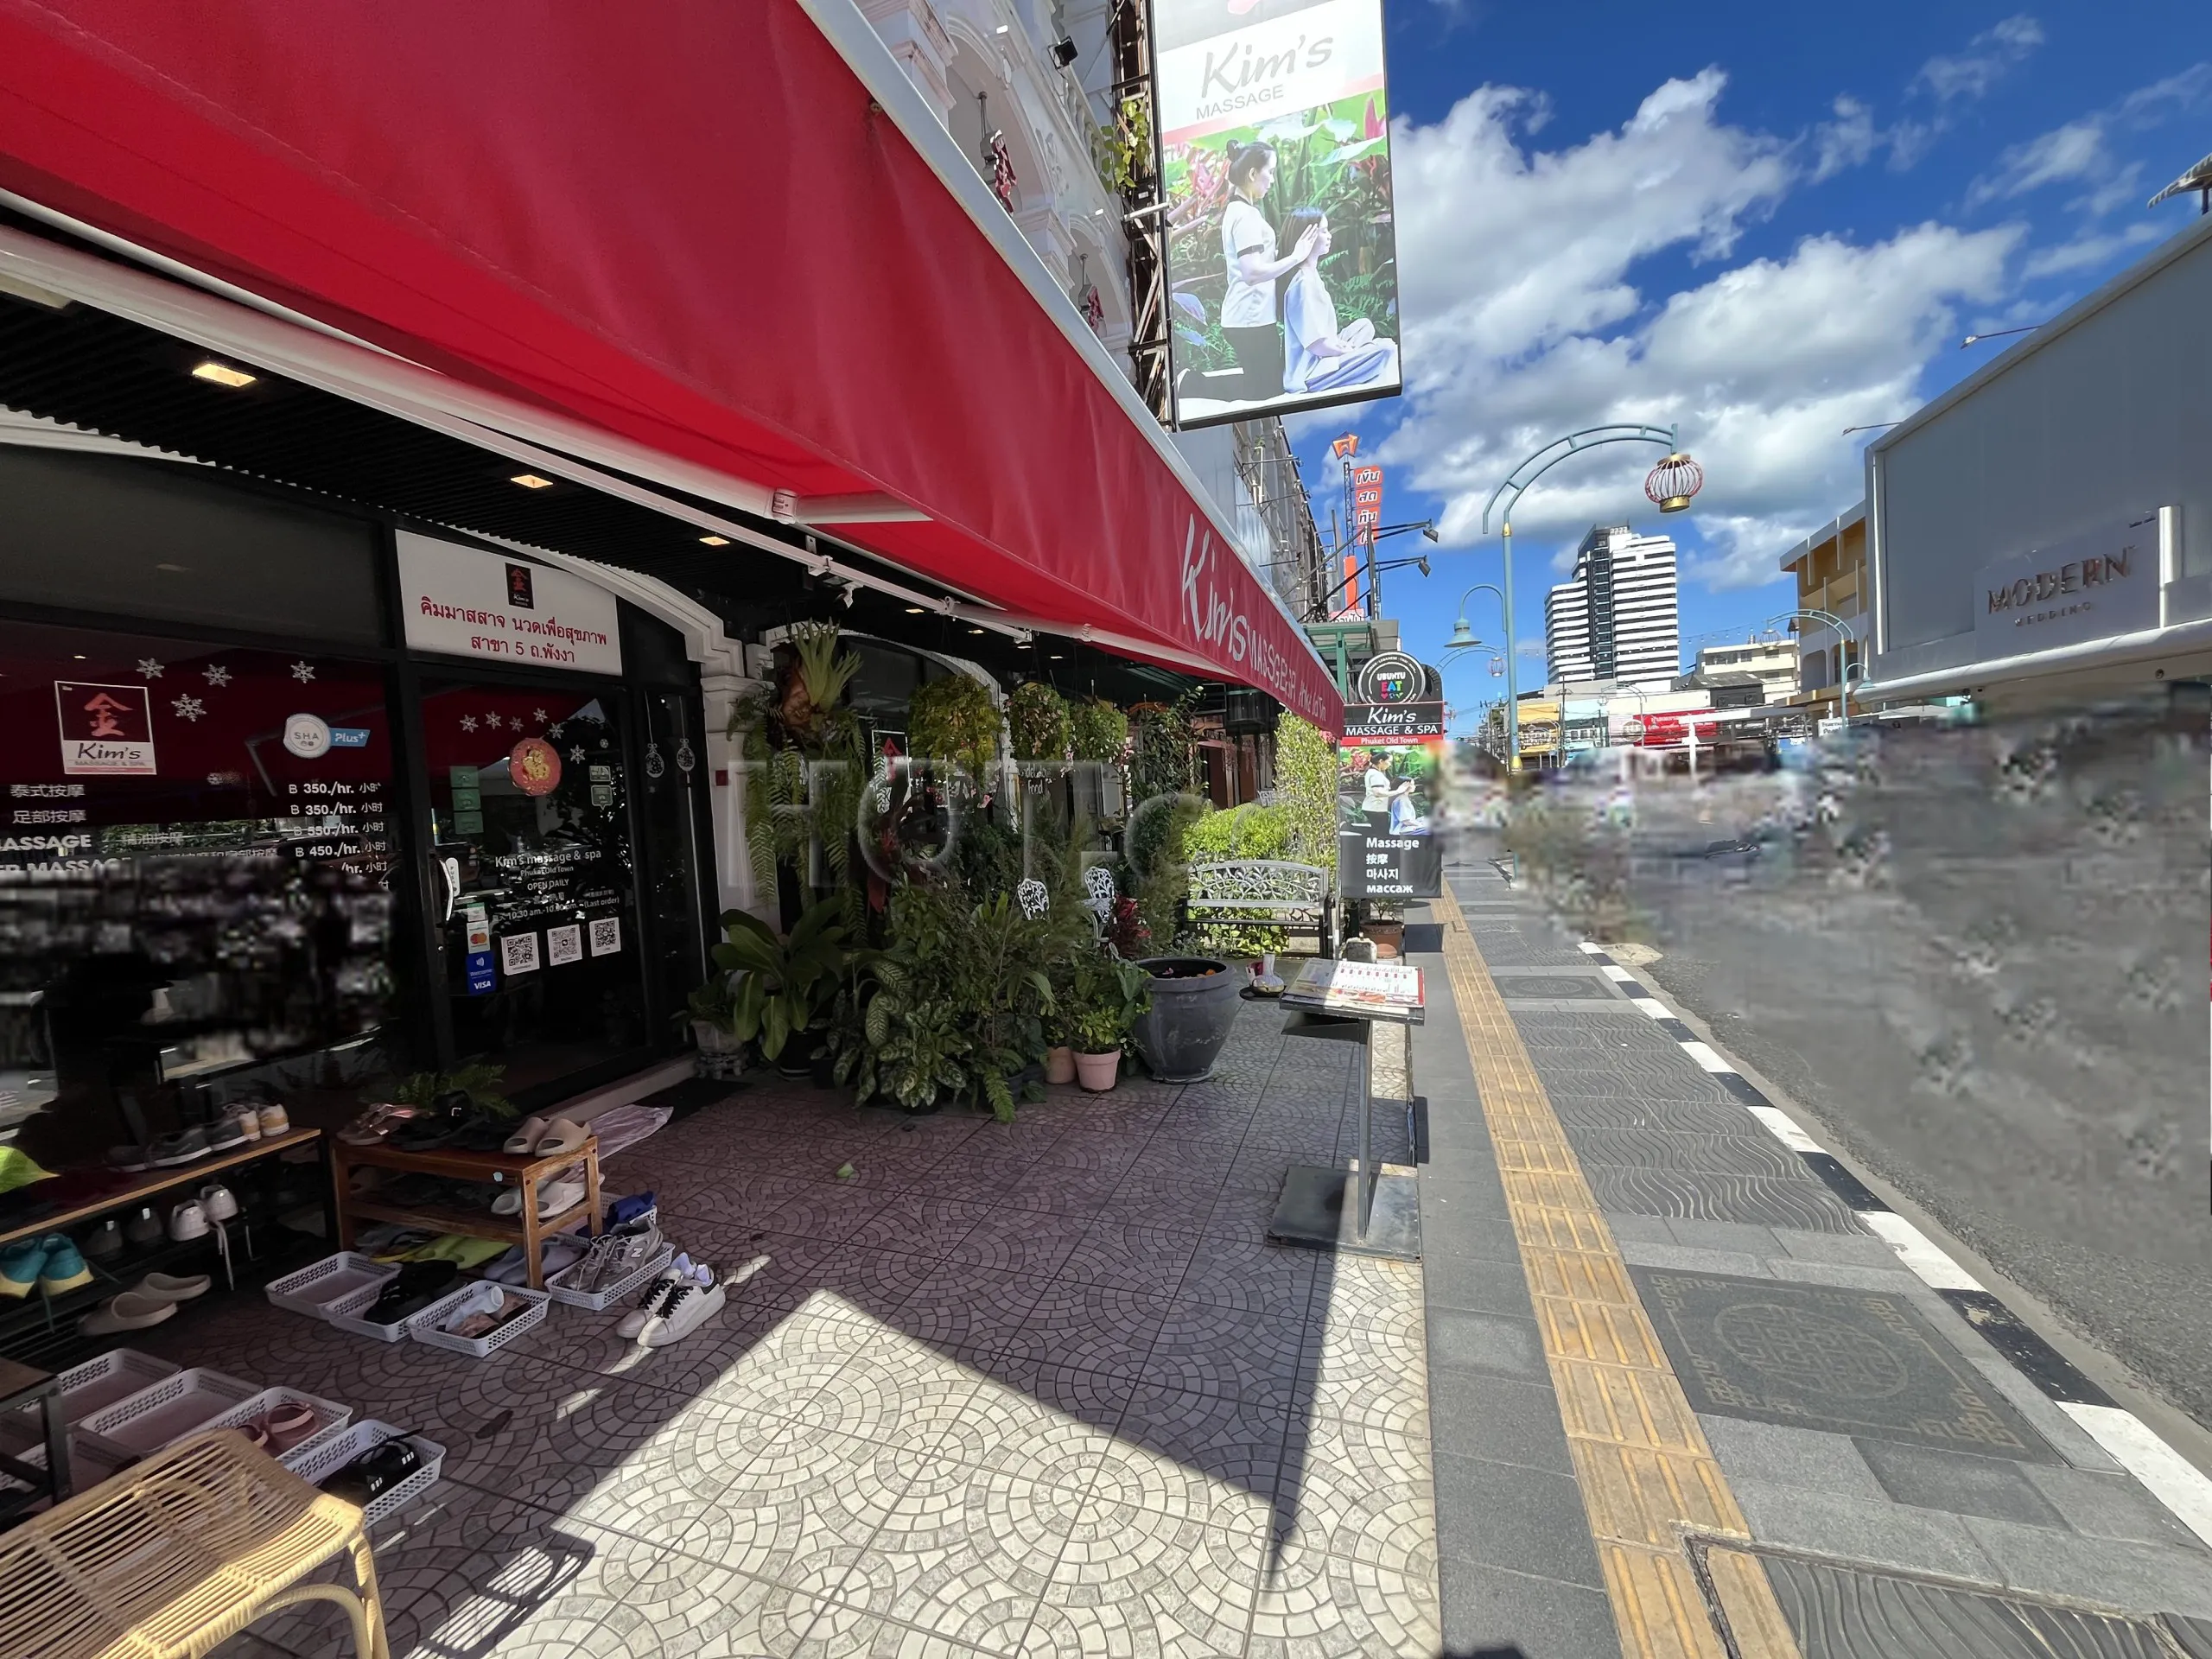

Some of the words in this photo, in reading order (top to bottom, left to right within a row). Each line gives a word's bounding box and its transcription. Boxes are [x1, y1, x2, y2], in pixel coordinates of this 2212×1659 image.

[1201, 35, 1333, 99] Kim's
[1196, 85, 1284, 120] MASSAGE
[1988, 545, 2136, 614] MODERN
[1182, 513, 1248, 661] Kim's
[421, 595, 505, 628] คิมมาสสาจ
[512, 617, 607, 645] นวดเพื่อสุขภาพ
[471, 635, 508, 653] สาขา
[515, 642, 524, 655] 5
[531, 642, 575, 663] ถ.พังงา
[1376, 672, 1406, 681] UBUNTU
[1381, 680, 1402, 692] EAT
[1367, 706, 1417, 724] Kim's
[1346, 727, 1399, 735] MASSAGE
[1404, 726, 1413, 734] &
[1417, 725, 1438, 734] SPA
[78, 742, 141, 760] Kim's
[10, 784, 86, 798] 泰式按摩
[1027, 779, 1044, 795] food
[361, 802, 383, 813] 小时
[12, 810, 87, 824] 足部按摩
[362, 821, 385, 833] 小时
[0, 834, 92, 852] ASSAGE
[365, 841, 386, 853] 小时
[1366, 837, 1420, 850] Massage
[527, 852, 572, 865] massage
[574, 849, 581, 860] &
[585, 850, 601, 861] spa
[1365, 853, 1389, 865] 按摩
[1366, 868, 1399, 880] 마사지
[527, 881, 548, 891] OPEN
[549, 879, 569, 890] DAILY
[1366, 885, 1414, 893] массаж
[601, 896, 620, 906] order)
[474, 980, 492, 990] VISA
